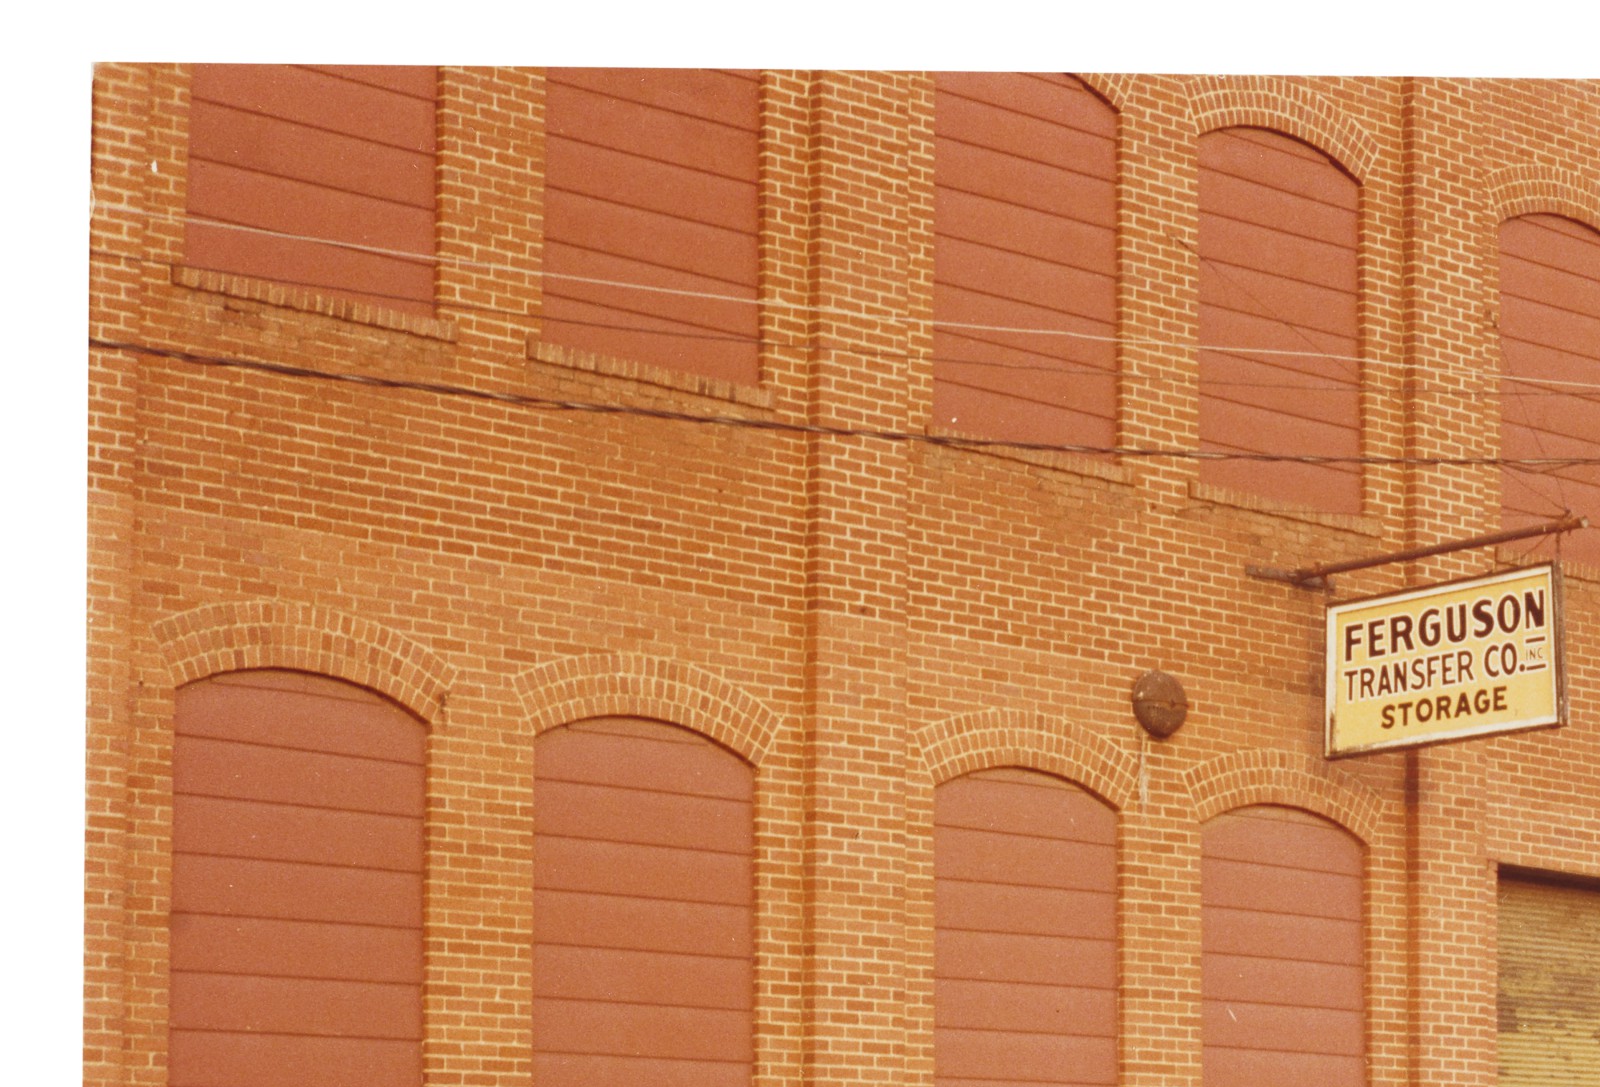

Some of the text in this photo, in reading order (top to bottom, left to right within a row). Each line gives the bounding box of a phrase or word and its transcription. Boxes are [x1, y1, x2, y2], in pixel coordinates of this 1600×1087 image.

[1345, 589, 1544, 661] FERGUSON
[1344, 643, 1543, 701] TRANSFER CO. INC
[1381, 686, 1508, 729] STORAGE
